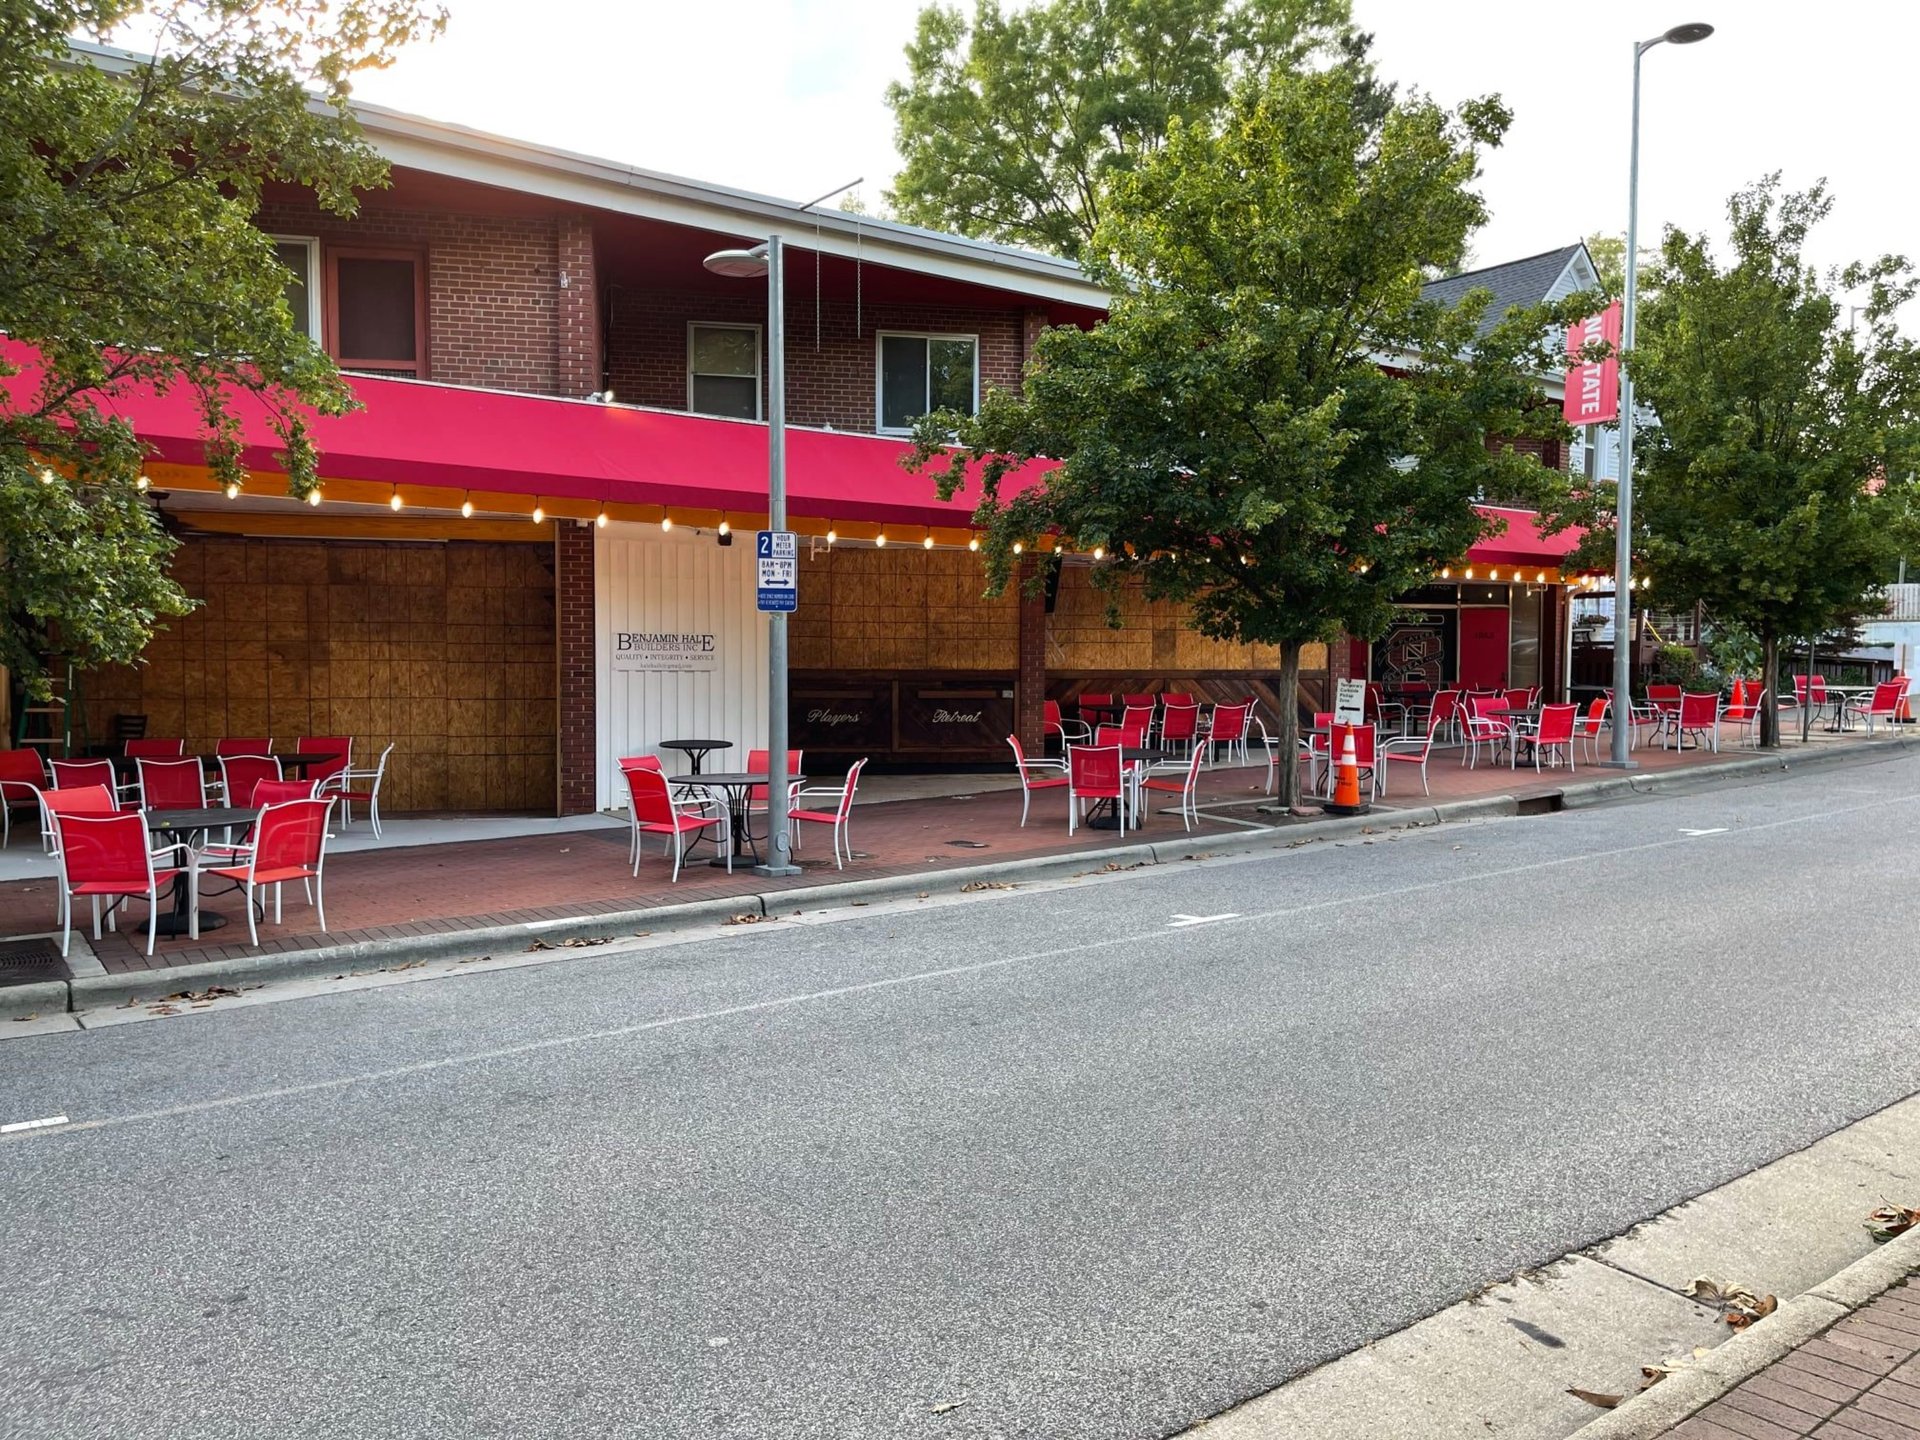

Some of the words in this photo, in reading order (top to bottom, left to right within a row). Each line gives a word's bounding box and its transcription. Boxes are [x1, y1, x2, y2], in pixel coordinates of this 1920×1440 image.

[760, 536, 769, 554] 2
[617, 633, 679, 650] BENJAMIN
[682, 634, 715, 651] HALE
[634, 643, 680, 651] BUILDERS
[683, 643, 698, 651] INC
[806, 708, 862, 727] Players'
[932, 708, 982, 723] Retreat
